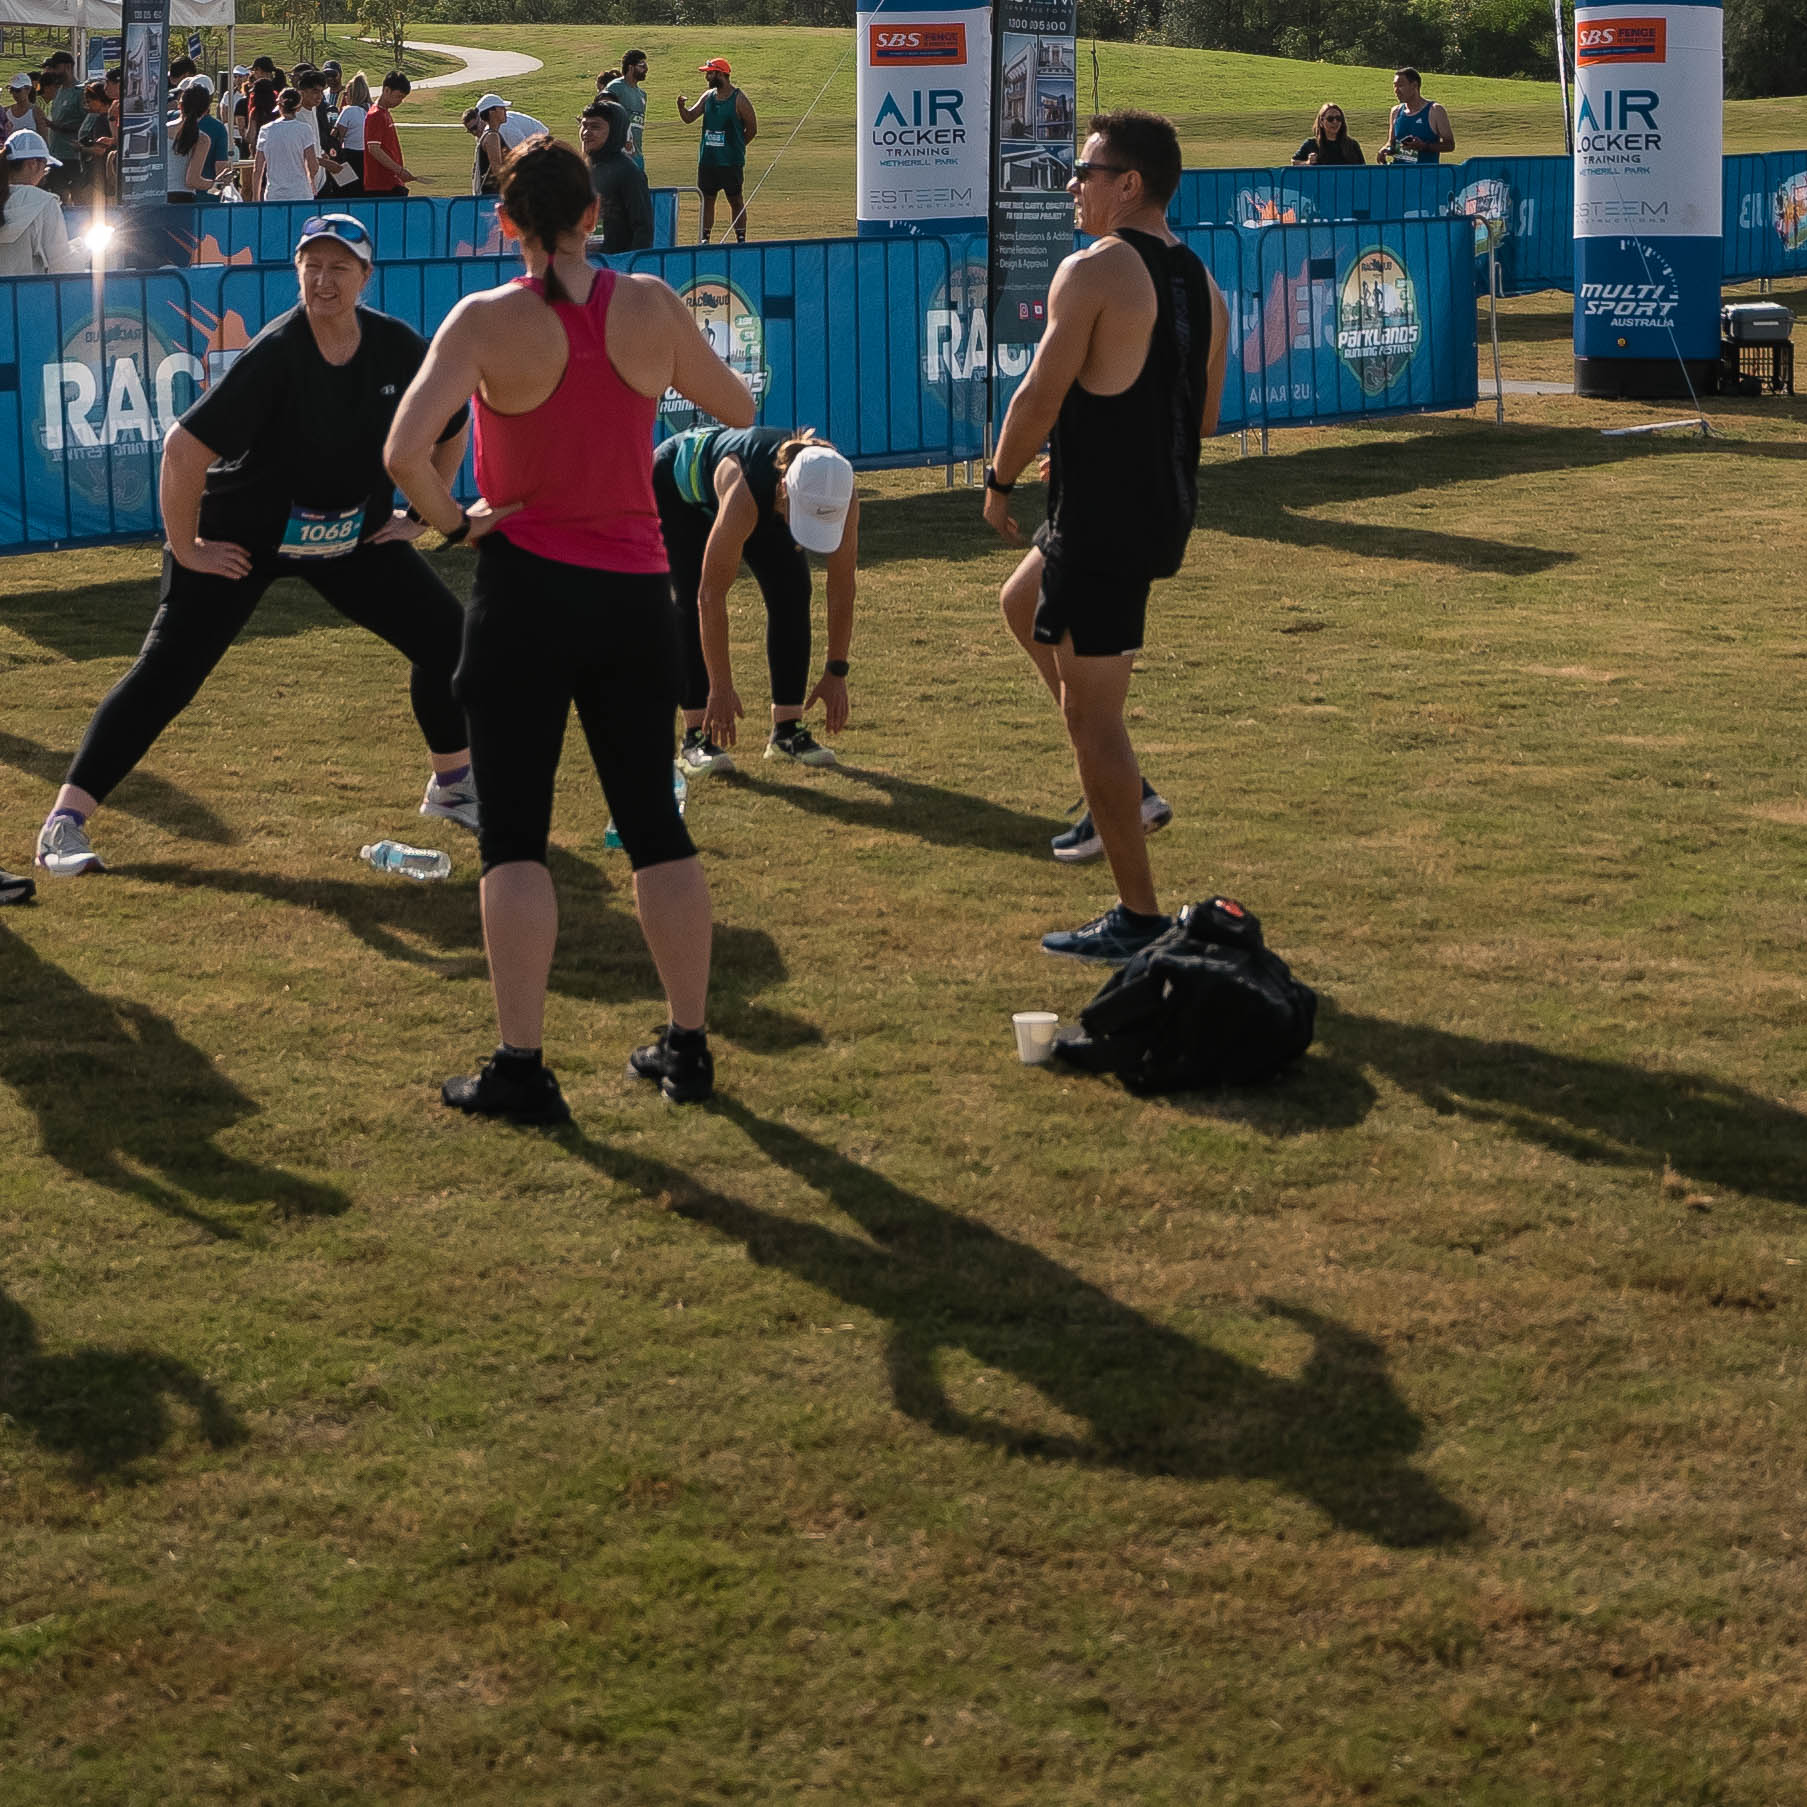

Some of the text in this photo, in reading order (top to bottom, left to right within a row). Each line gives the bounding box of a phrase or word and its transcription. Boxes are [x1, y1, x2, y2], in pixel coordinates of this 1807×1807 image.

[876, 32, 922, 48] SBS
[1579, 28, 1617, 46] SBS
[1618, 28, 1656, 37] FENCE
[874, 89, 964, 127] AIR
[1578, 90, 1660, 133] AIR
[873, 128, 966, 145] LOCKER
[886, 147, 950, 157] TRAINING
[1583, 154, 1641, 165] TRAINING
[880, 158, 959, 167] WETHERILL PARK
[1624, 167, 1651, 175] PARK
[870, 187, 972, 204] ESTEEM
[1580, 284, 1665, 299] MULTI
[1584, 300, 1679, 316] SPORT
[1610, 318, 1675, 327] AUSTRALIA
[300, 521, 354, 541] 1068
